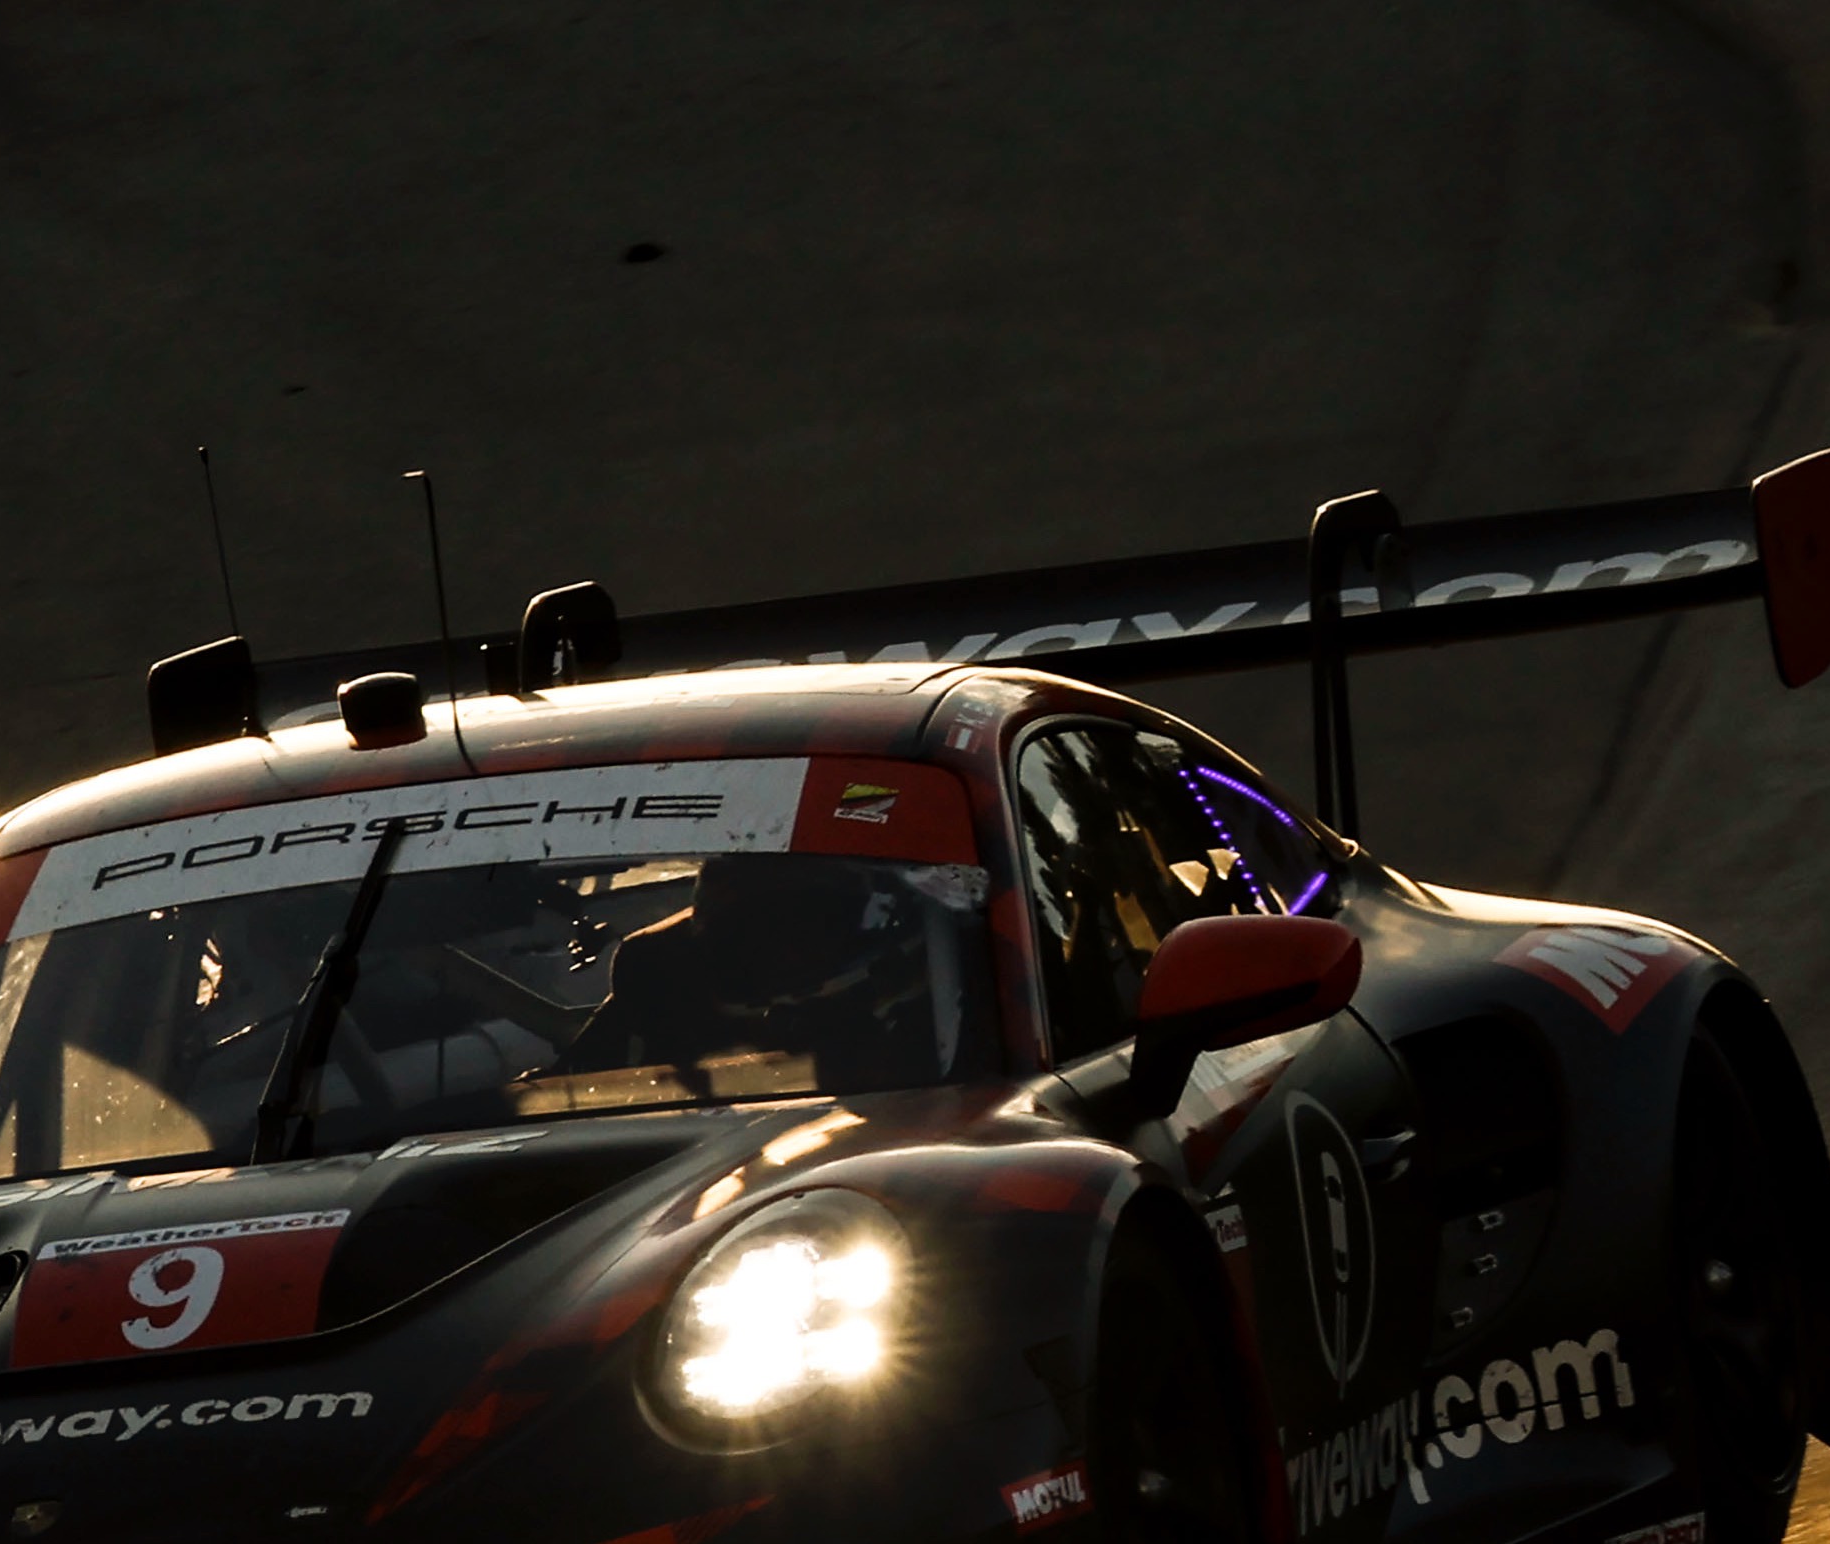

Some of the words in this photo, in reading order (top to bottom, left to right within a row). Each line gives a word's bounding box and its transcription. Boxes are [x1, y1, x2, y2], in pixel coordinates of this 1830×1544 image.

[92, 794, 725, 892] PORSCHE
[53, 1210, 346, 1257] WeatherTech
[121, 1245, 225, 1350] 9
[1279, 1327, 1637, 1538] riveway.com
[1011, 1470, 1087, 1523] MOTUL
